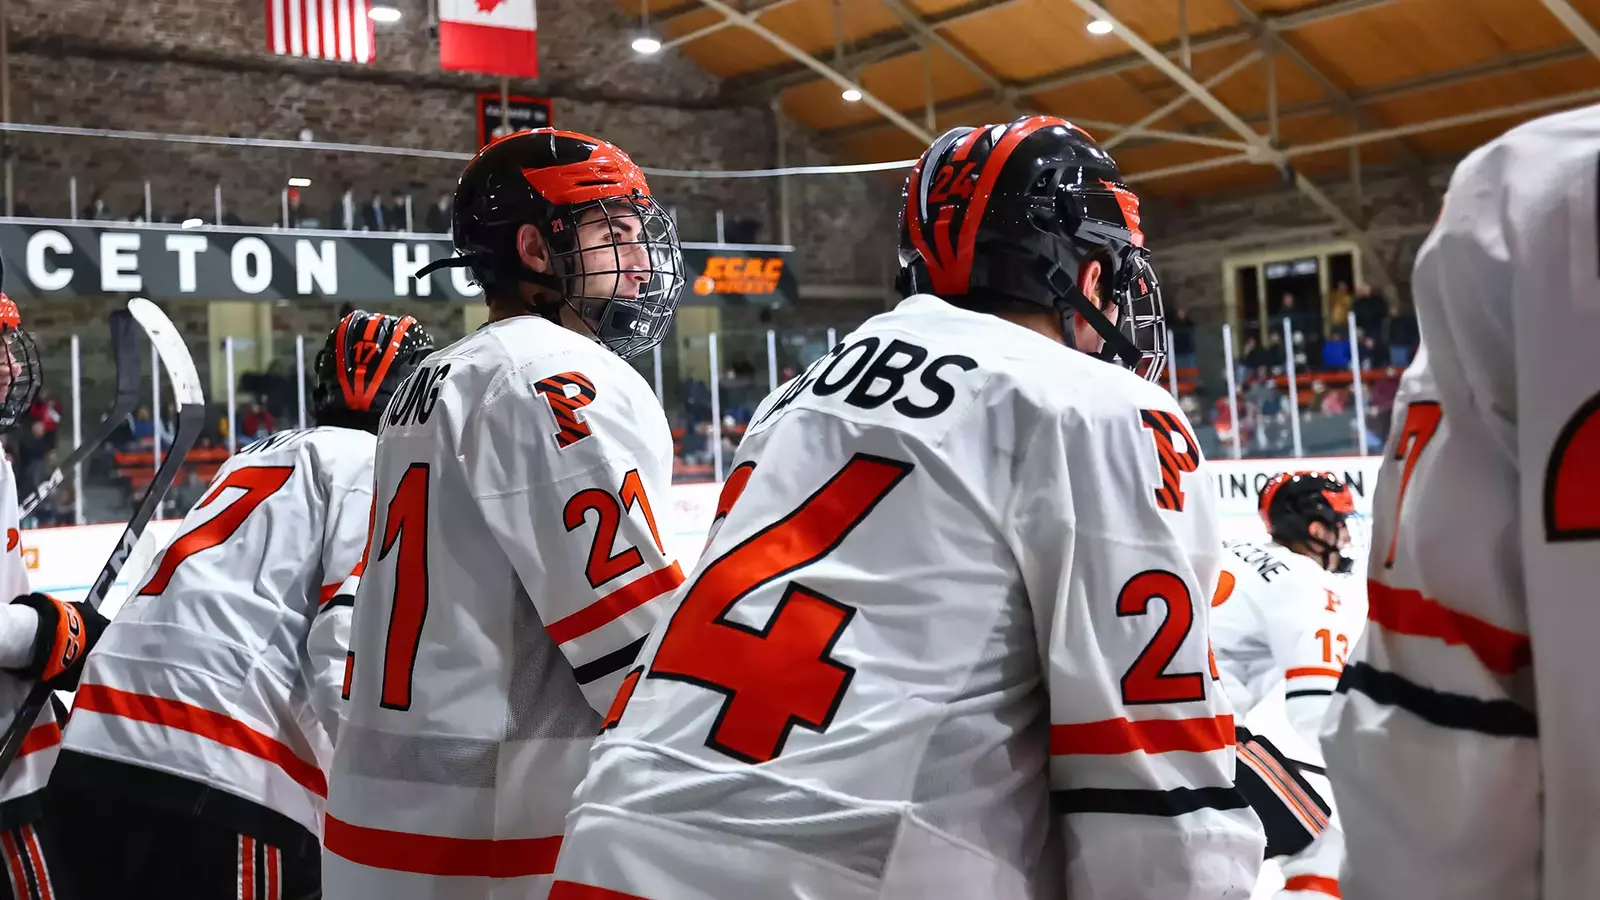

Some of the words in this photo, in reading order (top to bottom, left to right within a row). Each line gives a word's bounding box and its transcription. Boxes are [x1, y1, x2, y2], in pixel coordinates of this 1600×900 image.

[927, 162, 981, 204] 24
[26, 229, 339, 296] CETON
[703, 256, 784, 280] ECAC
[353, 340, 378, 364] 17
[532, 370, 597, 451] P
[1139, 408, 1200, 513] P
[136, 464, 295, 597] 7
[562, 468, 667, 590] 21
[342, 462, 430, 711] 1
[601, 451, 915, 766] 4
[1115, 568, 1220, 706] 2
[1314, 628, 1349, 669] 13
